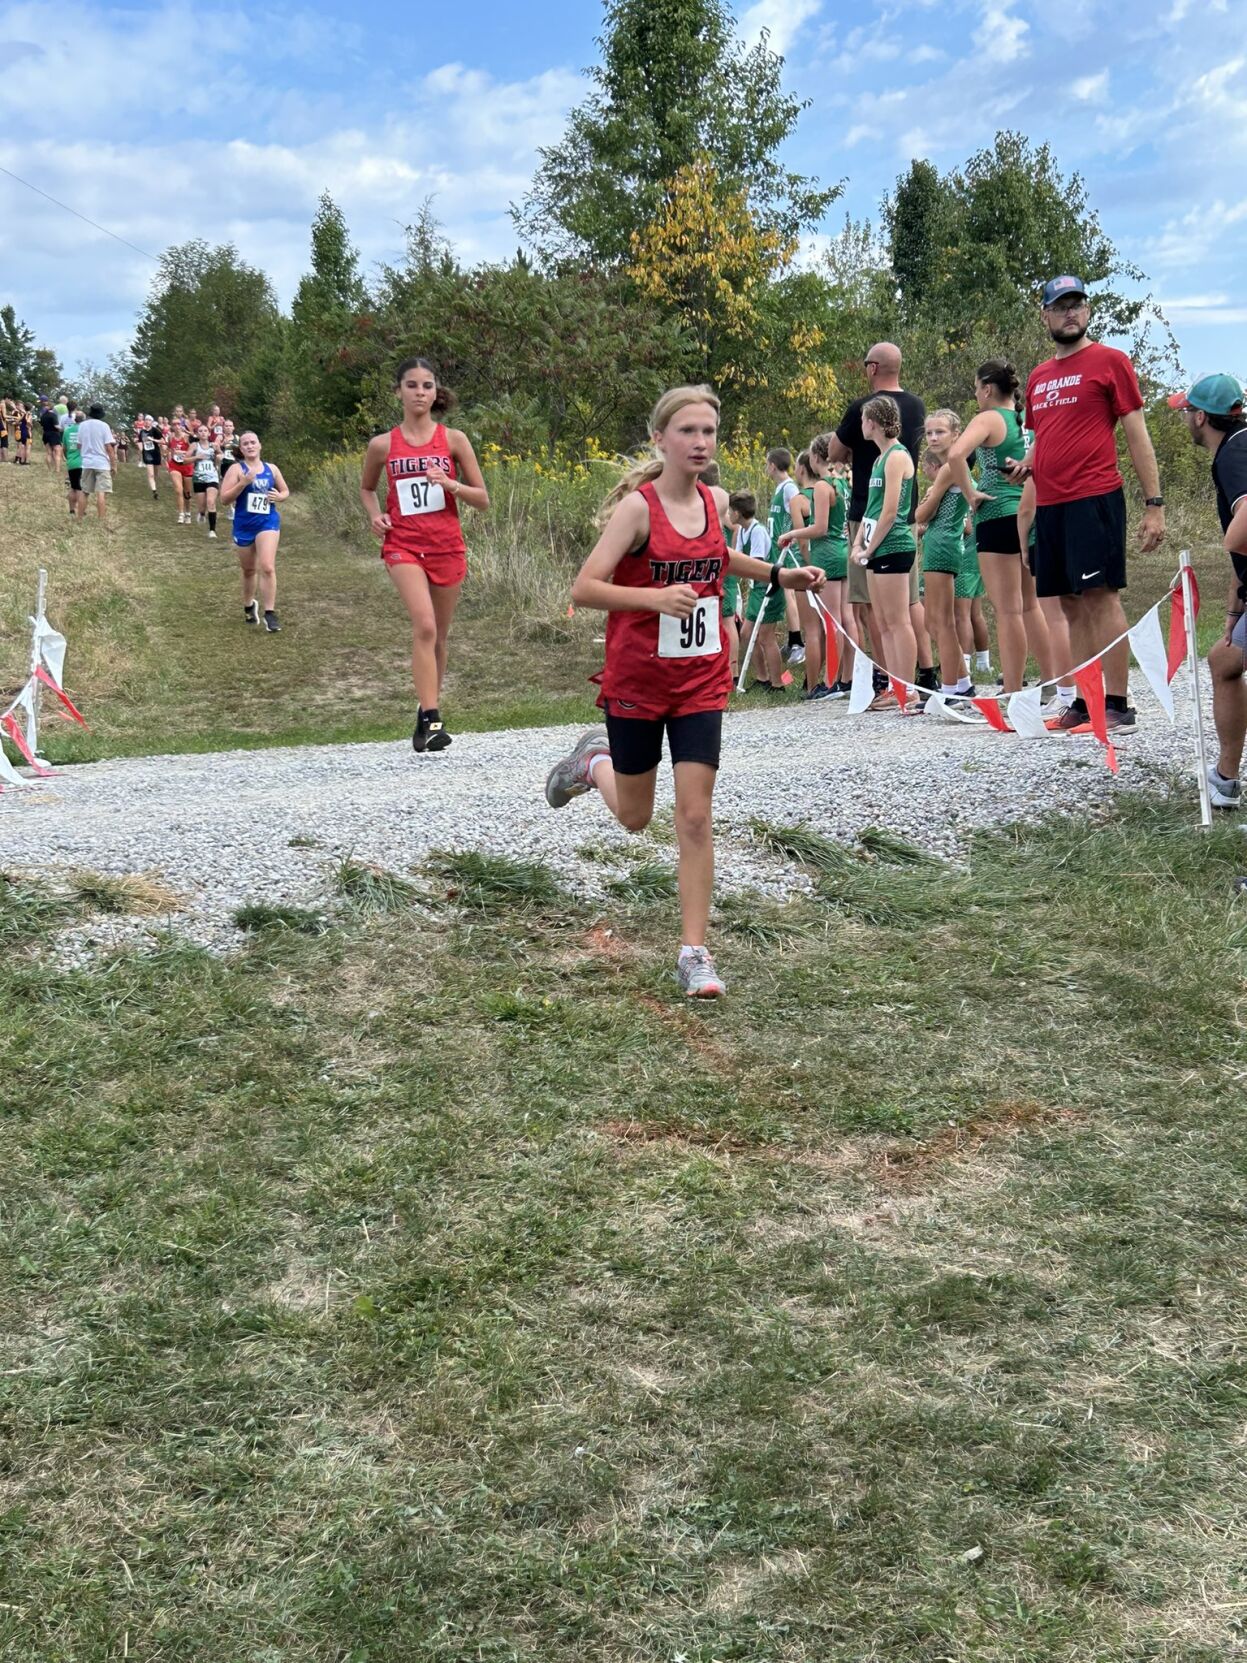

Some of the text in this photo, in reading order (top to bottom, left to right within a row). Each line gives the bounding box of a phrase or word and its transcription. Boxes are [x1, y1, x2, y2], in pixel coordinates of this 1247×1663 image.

[1046, 374, 1082, 391] GRANDE
[1055, 396, 1078, 406] FIELD
[389, 455, 451, 476] TIGERS
[252, 496, 268, 511] 479
[411, 482, 429, 508] 97
[649, 556, 722, 585] TIGER
[680, 607, 706, 649] 96
